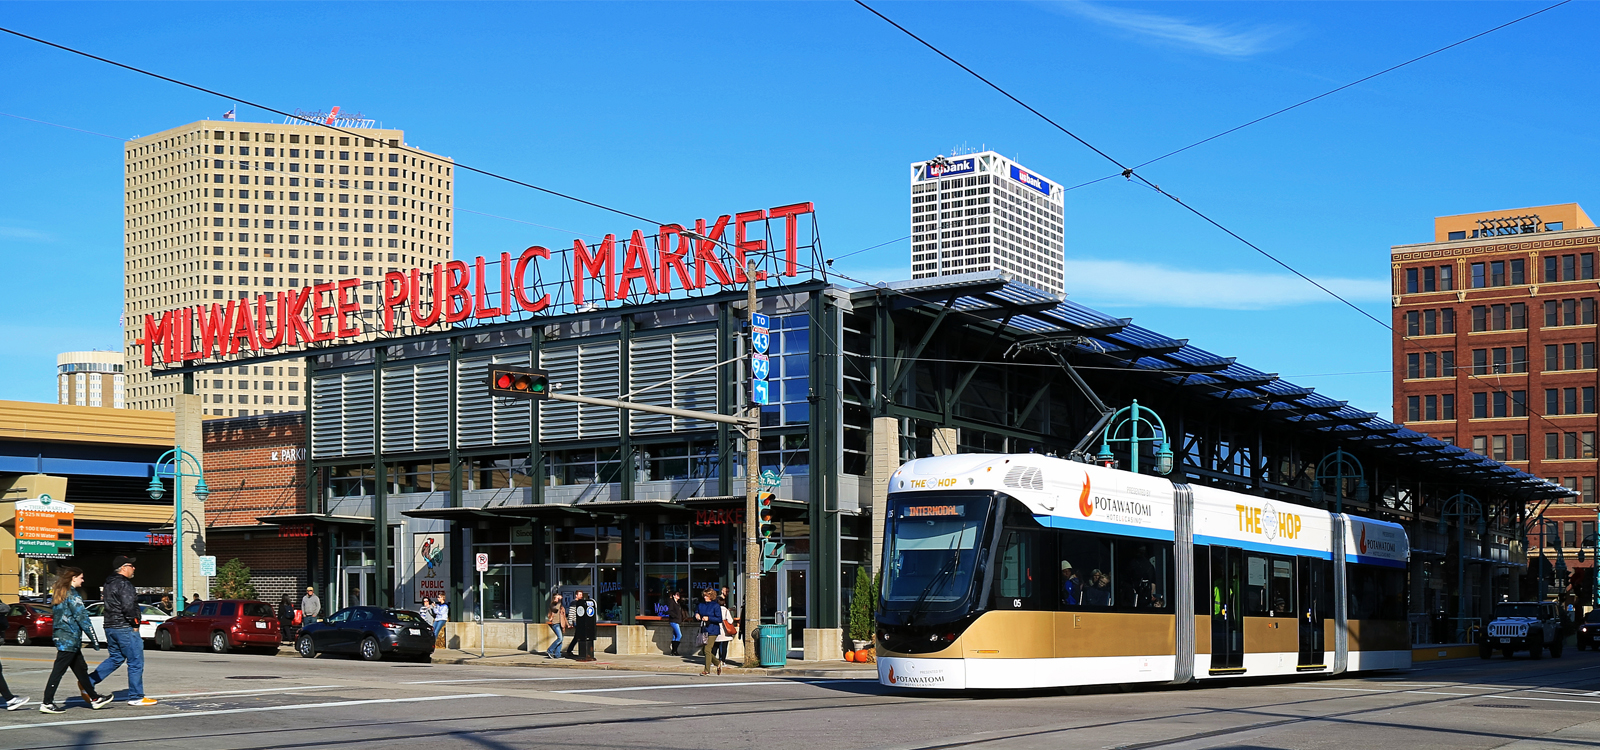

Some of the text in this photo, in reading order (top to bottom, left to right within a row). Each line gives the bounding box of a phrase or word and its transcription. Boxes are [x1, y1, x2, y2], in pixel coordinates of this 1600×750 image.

[144, 201, 814, 366] MILWAUKEE PUBLIC MARKET
[756, 316, 766, 325] TO
[754, 333, 768, 350] 43
[753, 360, 767, 376] 94
[910, 479, 927, 488] THE
[937, 478, 957, 487] HOP
[909, 505, 959, 517] INTERMODAL
[1094, 496, 1152, 517] POTAWATOMI
[696, 508, 747, 526] MARKE
[1235, 504, 1262, 535] THE
[1278, 512, 1302, 540] HOP
[1367, 539, 1396, 552] POTAWATOMI
[420, 580, 444, 589] PUBLIC
[1013, 599, 1022, 608] 05
[896, 675, 945, 683] POTAWATOMI
